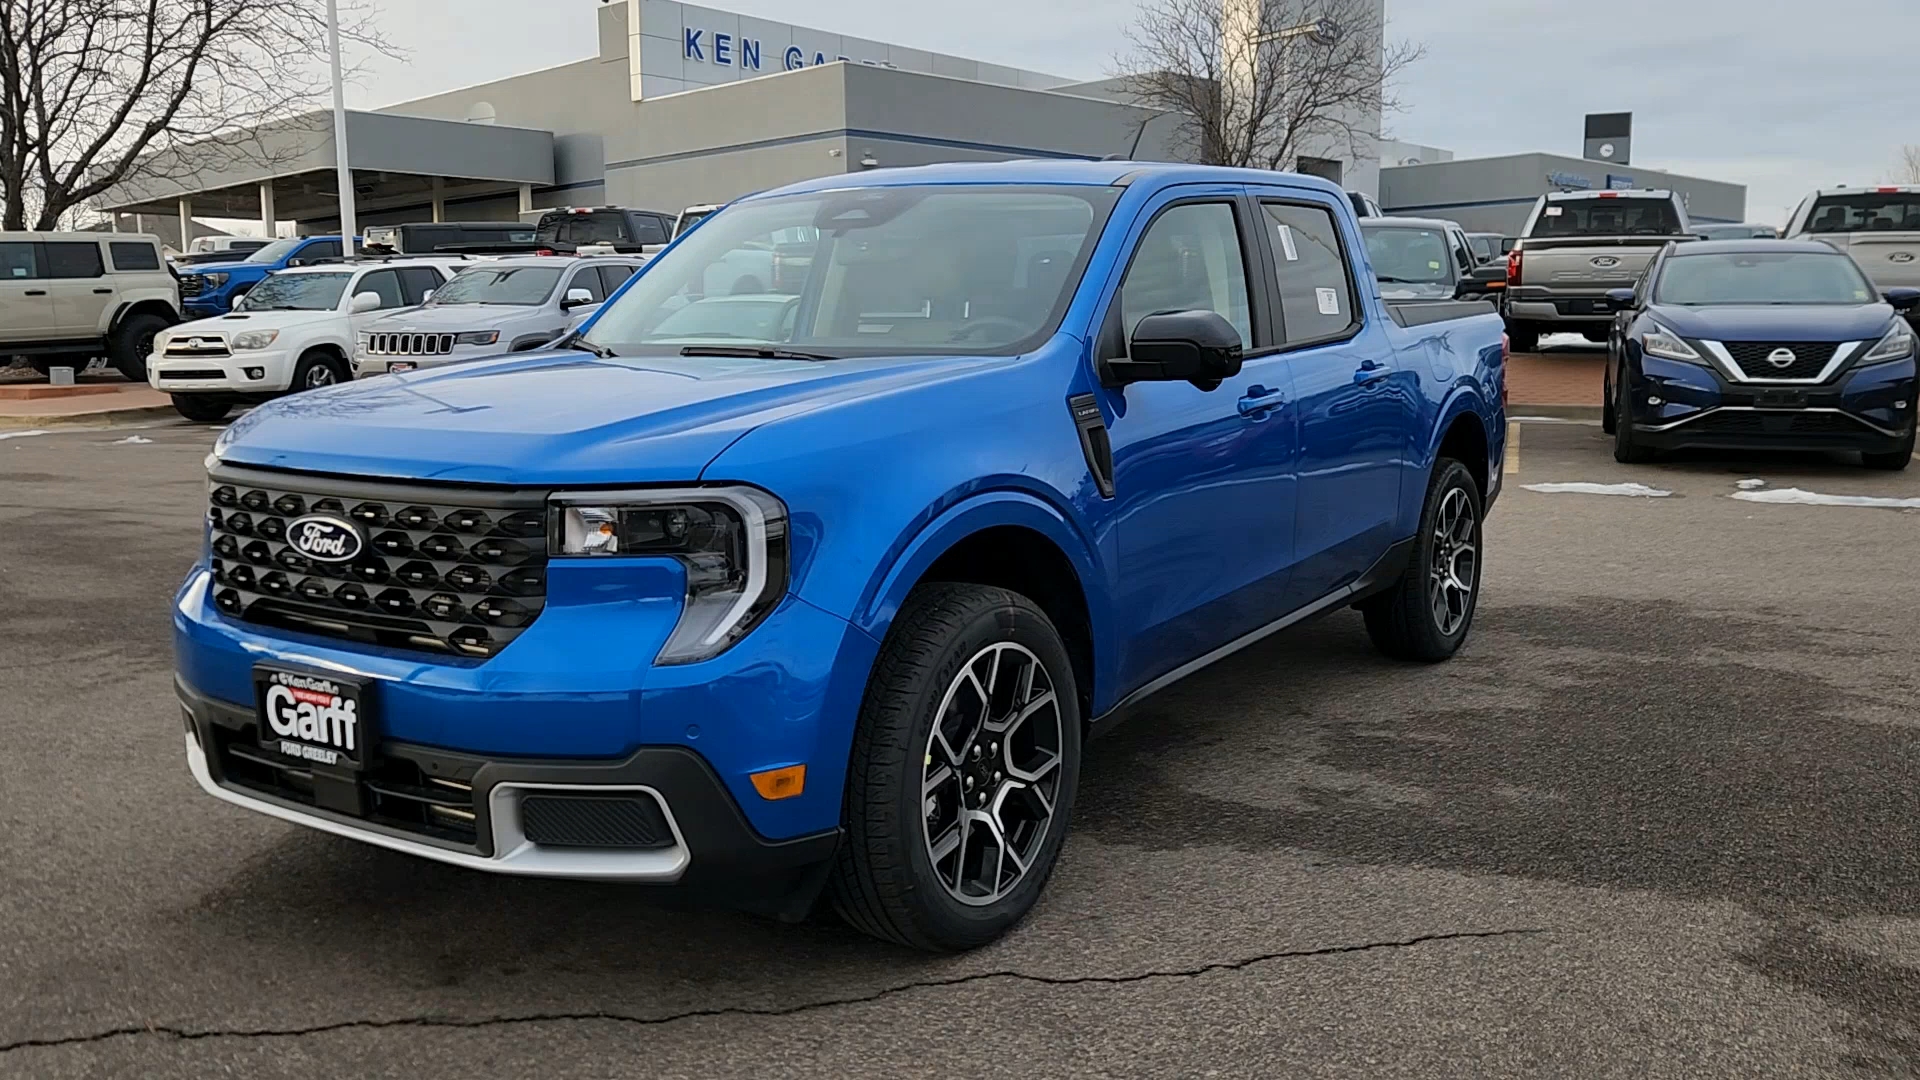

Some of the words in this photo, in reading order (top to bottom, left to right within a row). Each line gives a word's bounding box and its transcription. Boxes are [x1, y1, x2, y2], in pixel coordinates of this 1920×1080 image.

[685, 27, 760, 70] KEN
[300, 522, 346, 555] Ford
[266, 684, 357, 750] Garff
[281, 741, 301, 757] FORD
